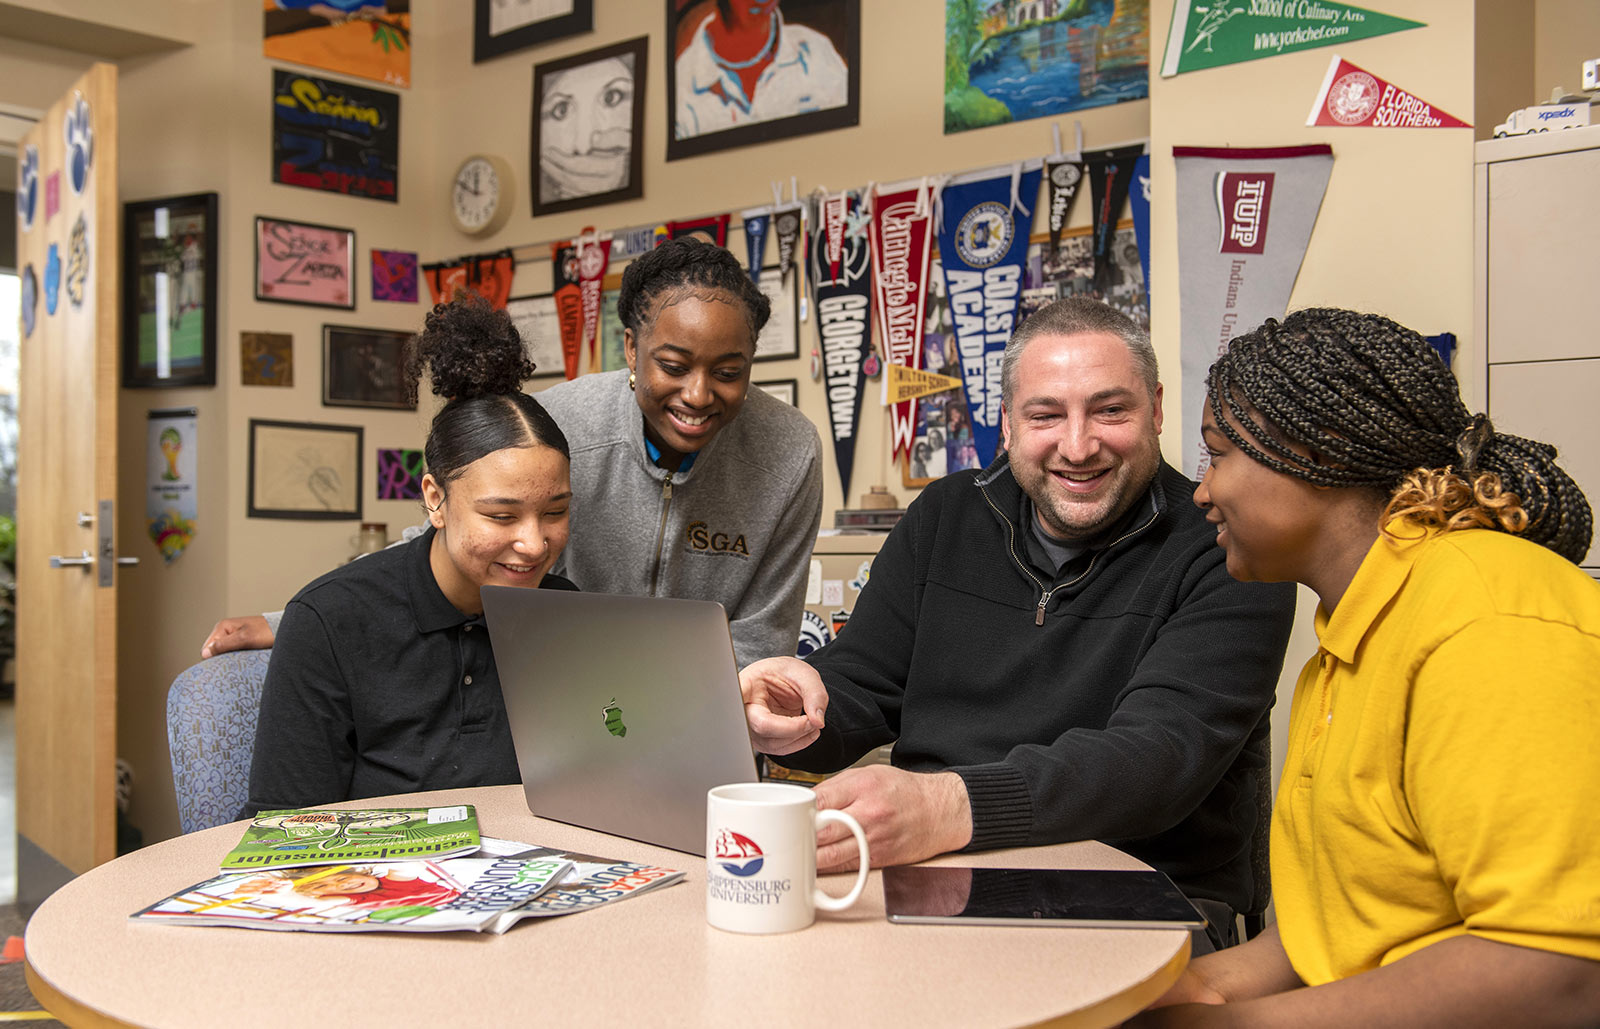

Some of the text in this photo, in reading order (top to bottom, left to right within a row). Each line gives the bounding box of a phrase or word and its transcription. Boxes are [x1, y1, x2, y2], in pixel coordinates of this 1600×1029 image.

[1284, 0, 1298, 18] of
[1297, 0, 1341, 24] Culinary
[1341, 9, 1366, 22] Arts
[1380, 84, 1431, 116] FLORIDA
[1537, 107, 1576, 121] xpedx
[1372, 106, 1442, 127] SOUTHERN
[880, 202, 928, 371] Carnegie Mello
[1224, 259, 1246, 310] Indiana
[983, 264, 1022, 344] COAST
[946, 269, 987, 428] ACADEMY
[1216, 312, 1238, 358] Univer
[818, 294, 868, 438] GEORGETOWN
[985, 349, 1005, 427] GUARD
[691, 529, 750, 555] SGA
[230, 837, 473, 865] schoolcounselor
[514, 860, 560, 884] SCA
[707, 870, 792, 893] SHIPPENSBURG
[709, 886, 784, 905] UNIVERSITY
